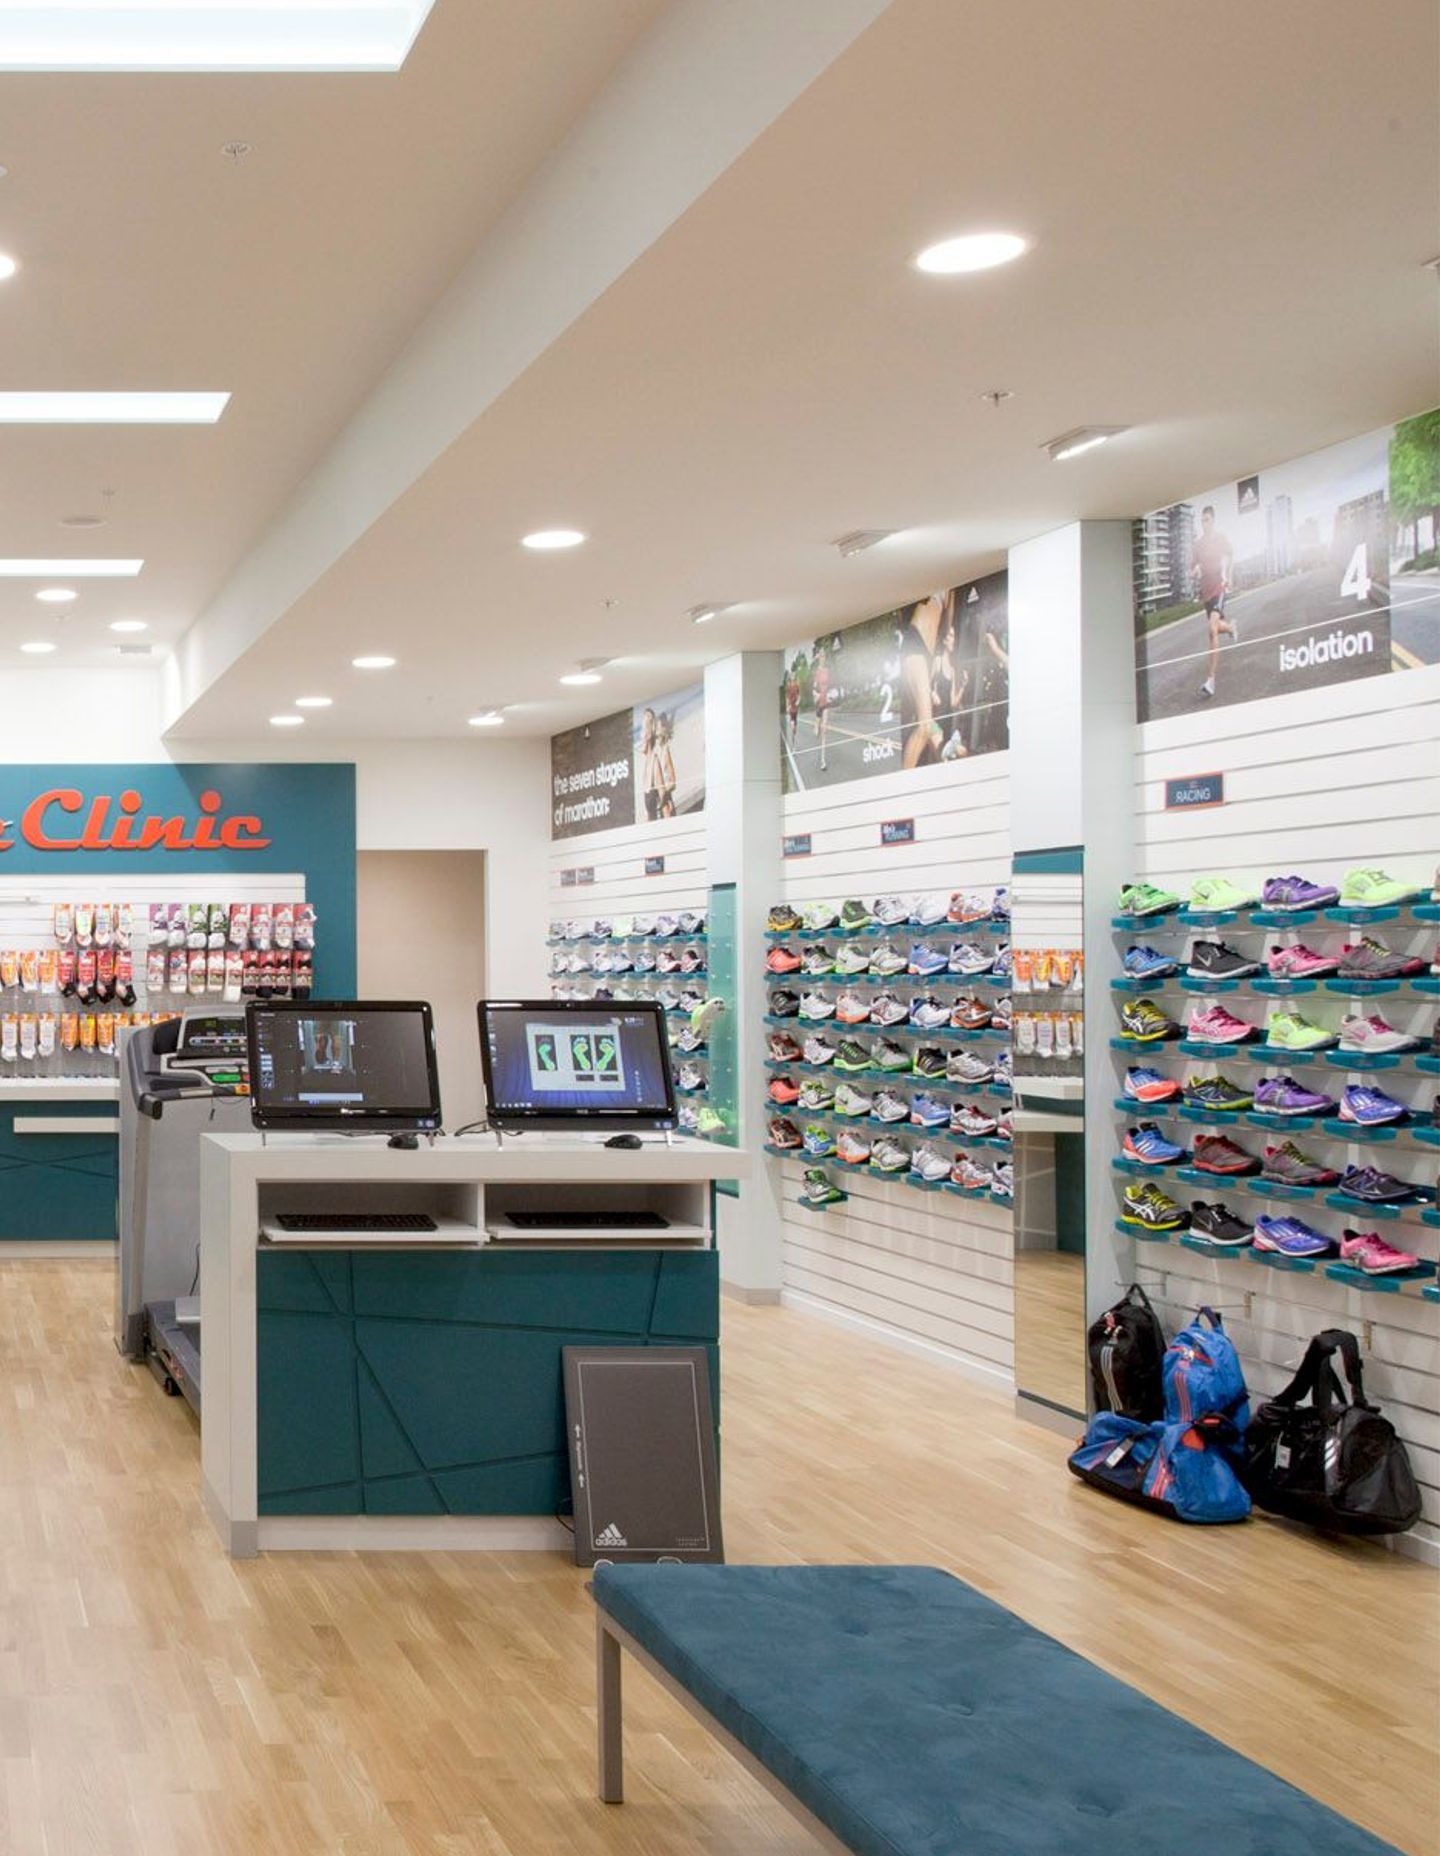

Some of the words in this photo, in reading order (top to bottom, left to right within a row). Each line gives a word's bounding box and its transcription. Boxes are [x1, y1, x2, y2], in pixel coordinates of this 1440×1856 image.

[1341, 542, 1372, 600] 4
[1279, 630, 1374, 671] isolation
[879, 684, 893, 722] 2
[863, 738, 894, 762] shock
[554, 773, 569, 796] the
[569, 769, 595, 793] seven
[595, 759, 629, 787] stages
[1175, 787, 1211, 803] RACING
[21, 789, 272, 850] Clinic
[554, 802, 564, 826] of
[595, 1538, 628, 1547] adidas
